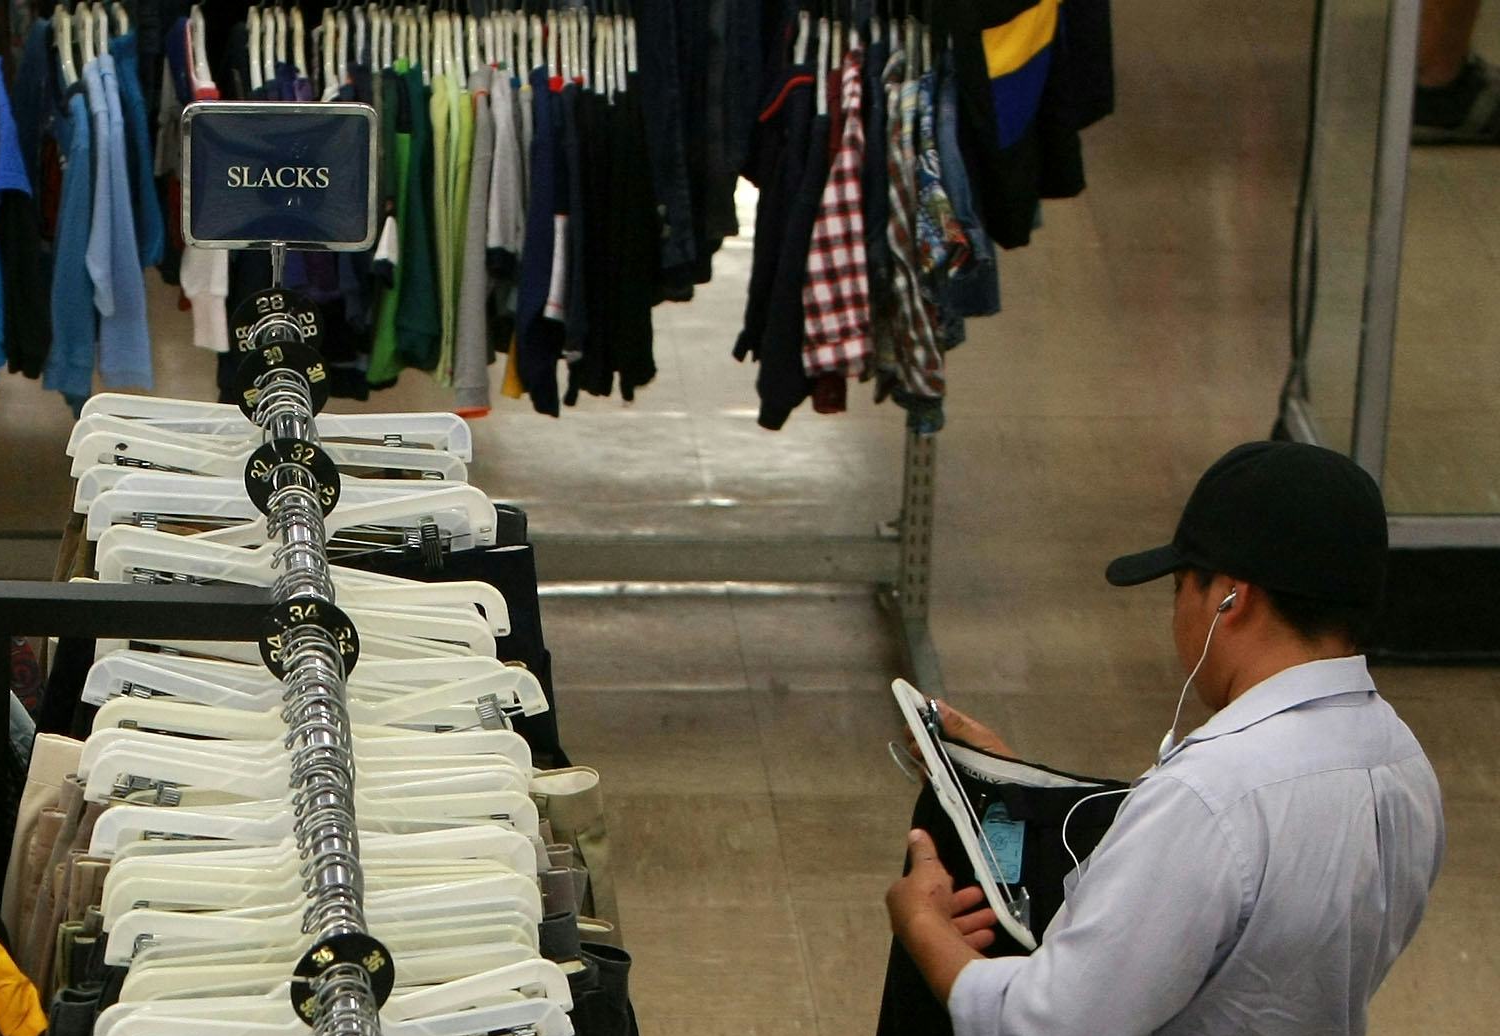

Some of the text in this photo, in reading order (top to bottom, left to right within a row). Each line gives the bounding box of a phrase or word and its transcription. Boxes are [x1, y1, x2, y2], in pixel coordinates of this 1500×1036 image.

[227, 166, 330, 188] SLACKS
[256, 294, 285, 314] 28
[298, 311, 318, 338] 28
[235, 325, 256, 352] 28
[263, 346, 284, 365] 30
[306, 363, 326, 383] 30
[291, 443, 315, 466] 32
[289, 603, 319, 622] 34
[312, 946, 334, 967] 36
[363, 950, 385, 973] 36
